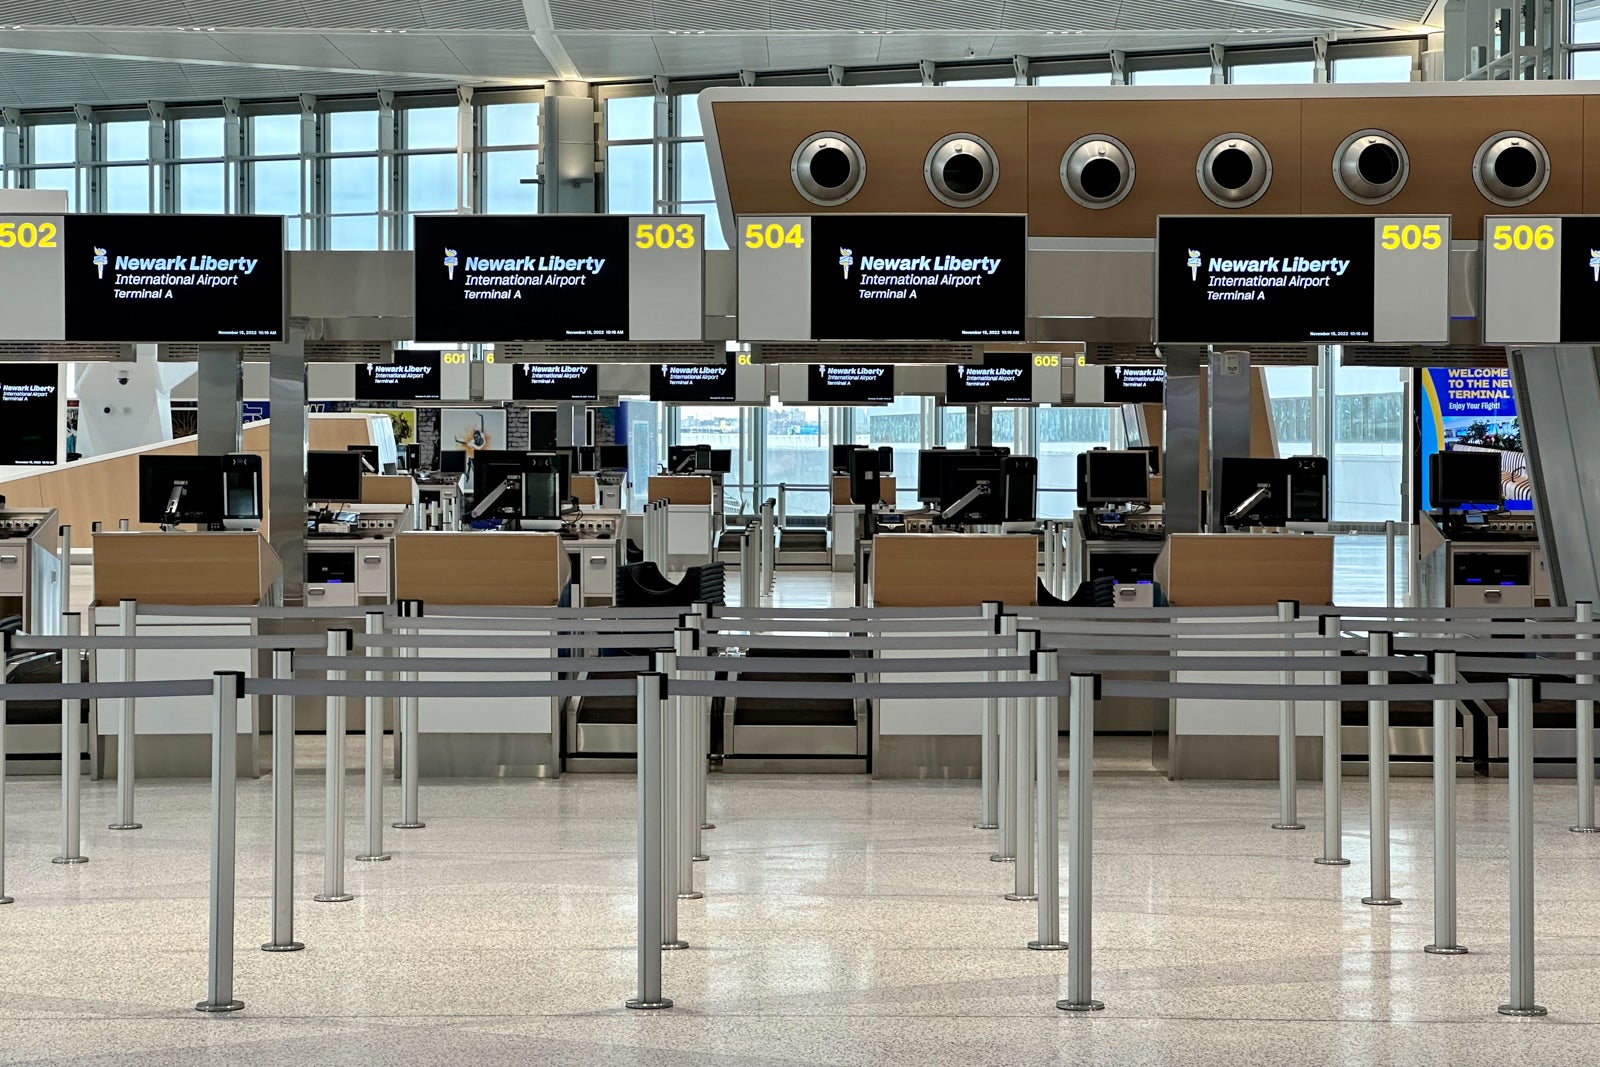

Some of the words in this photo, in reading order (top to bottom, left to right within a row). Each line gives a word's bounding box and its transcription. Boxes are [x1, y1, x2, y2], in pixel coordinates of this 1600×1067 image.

[0, 222, 57, 248] 502
[635, 223, 695, 250] 503
[745, 223, 805, 249] 504
[1382, 224, 1442, 250] 505
[1493, 224, 1555, 251] 506
[115, 255, 188, 271] Newark
[189, 255, 258, 275] Liberty
[464, 256, 537, 272] Newark
[537, 255, 606, 275] Liberty
[860, 256, 932, 271] Newark
[933, 255, 1002, 275] Liberty
[1208, 257, 1280, 273] Newark
[1281, 257, 1351, 276] Liberty
[114, 274, 195, 286] International
[195, 275, 239, 288] Airport
[464, 274, 543, 286] International
[544, 274, 586, 288] Airport
[860, 274, 939, 286] International
[939, 274, 982, 288] Airport
[1207, 275, 1288, 287] International
[1287, 275, 1331, 289] Airport
[113, 289, 163, 299] Terminal
[164, 289, 173, 299] A
[463, 289, 512, 300] Terminal
[513, 290, 522, 300] A
[859, 289, 907, 299] Terminal
[908, 289, 917, 299] A
[1207, 290, 1255, 301] Terminal
[1257, 291, 1266, 301] A
[443, 353, 466, 364] 601
[1034, 356, 1059, 367] 605
[404, 365, 431, 374] Liberty
[560, 365, 588, 374] Liberty
[699, 367, 727, 375] Liberty
[827, 367, 857, 375] Newark
[857, 367, 884, 376] Liberty
[995, 368, 1023, 376] Liberty
[1448, 368, 1509, 378] WELCOME
[30, 385, 55, 393] Liberty
[1448, 379, 1464, 388] TO
[1466, 379, 1490, 388] THE
[1448, 390, 1510, 399] TERMINAL
[1449, 402, 1465, 411] Enjoy
[1466, 402, 1481, 410] Your
[1481, 402, 1500, 411] Flight!
